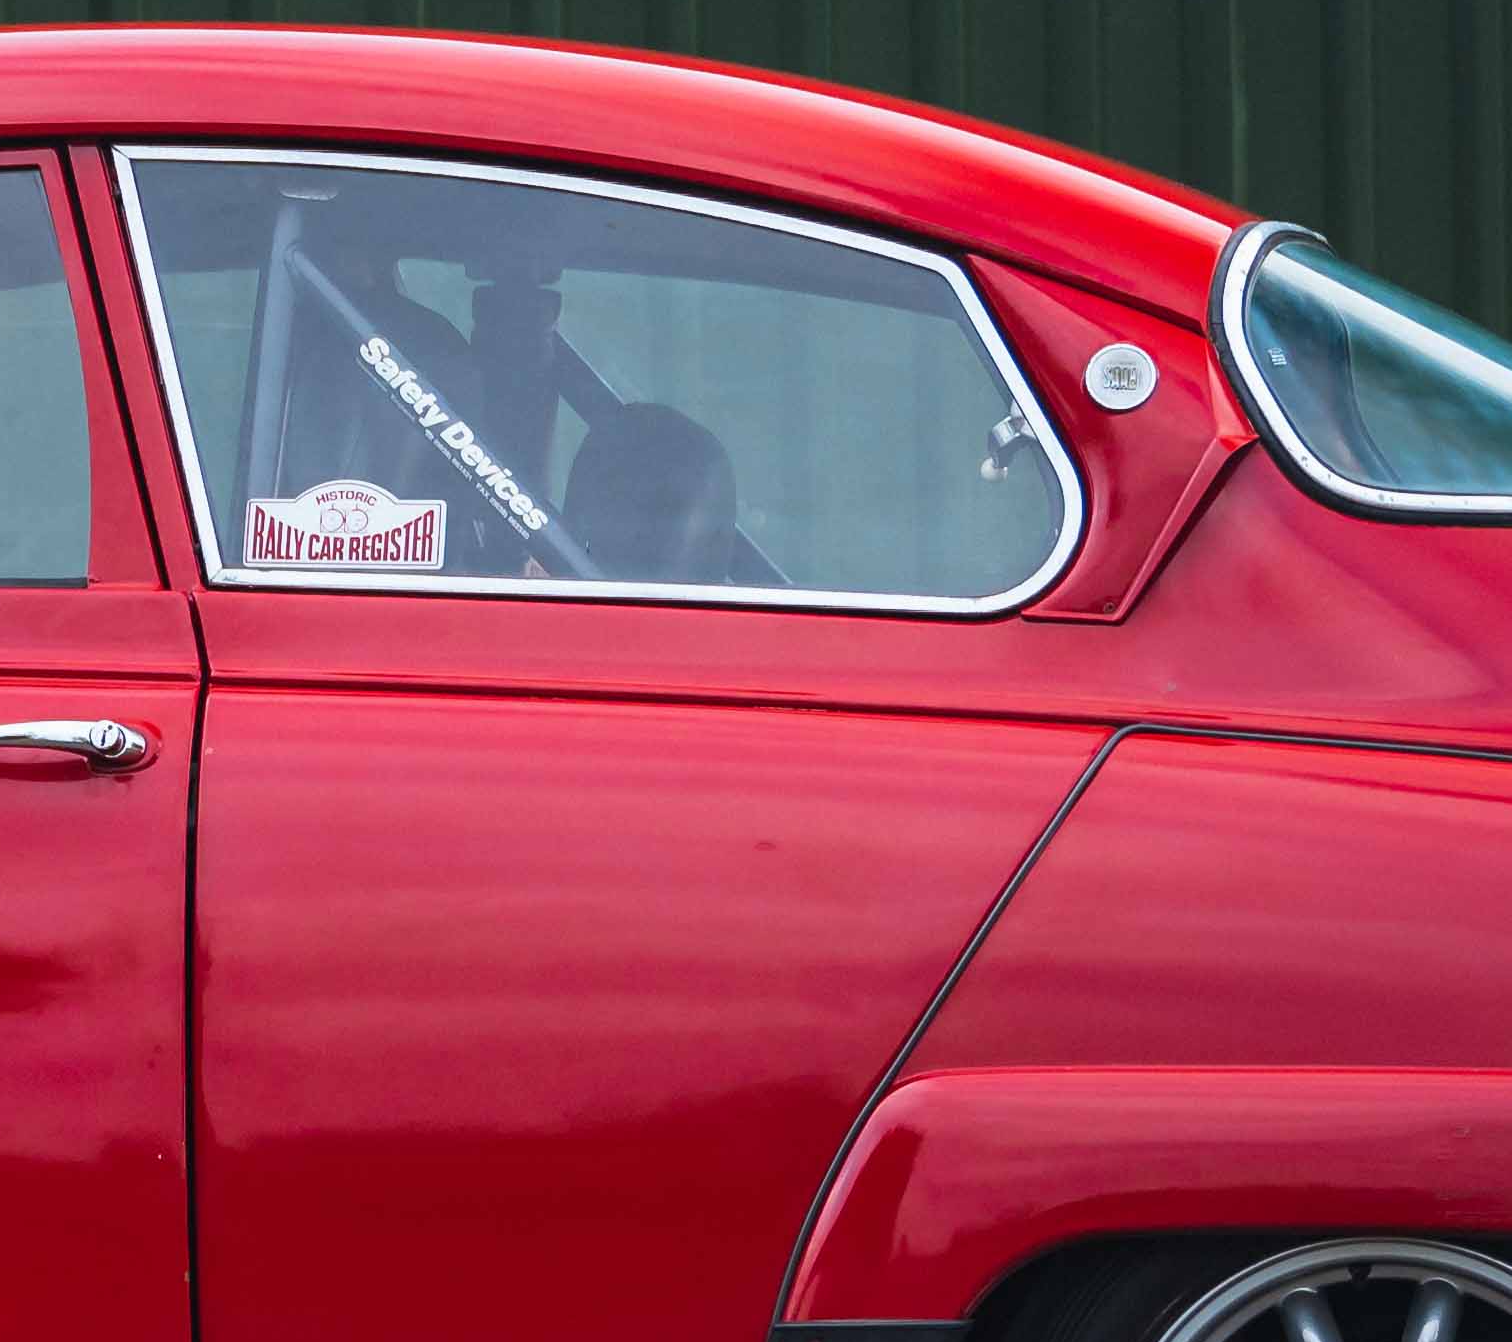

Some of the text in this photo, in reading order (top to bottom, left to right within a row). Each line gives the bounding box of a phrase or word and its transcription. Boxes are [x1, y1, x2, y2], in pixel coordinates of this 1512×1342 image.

[360, 337, 450, 429] Safety
[439, 420, 549, 531] Devices
[315, 490, 377, 506] HISTORIC
[252, 505, 305, 560] RALLY
[307, 534, 344, 560] CAR
[349, 510, 434, 563] REGISTER
